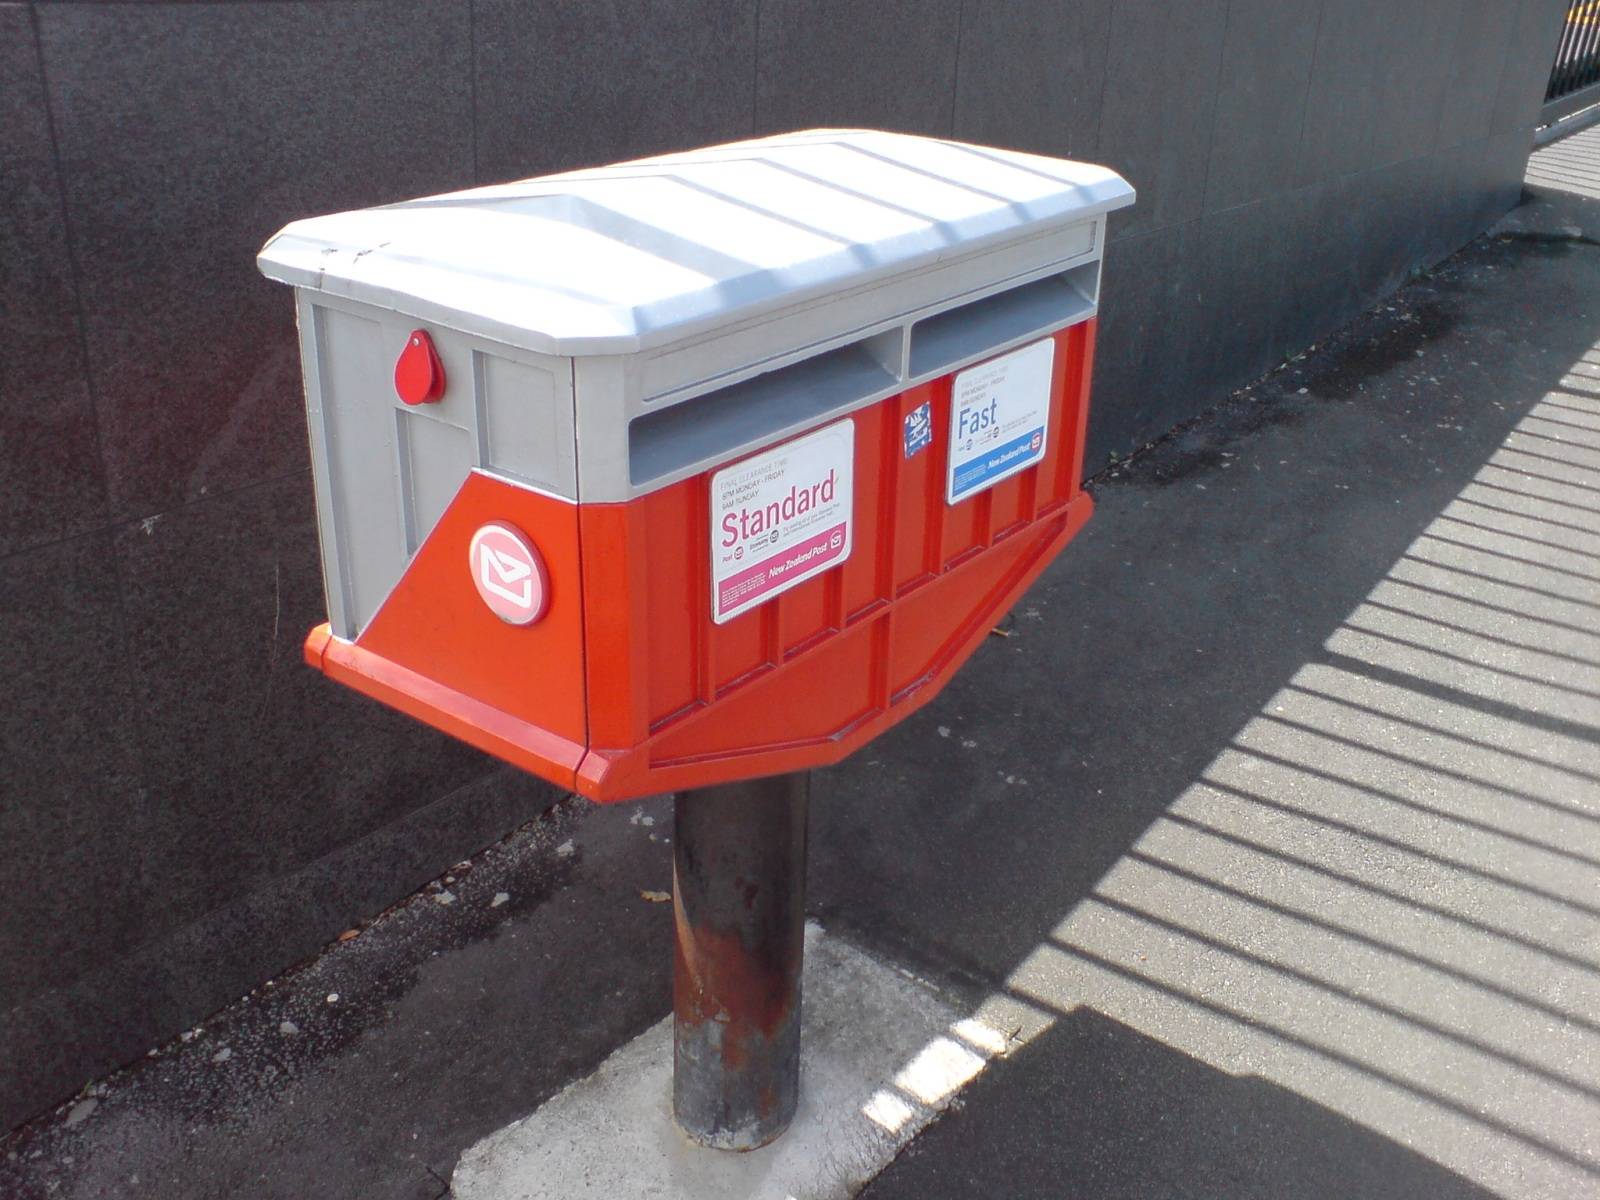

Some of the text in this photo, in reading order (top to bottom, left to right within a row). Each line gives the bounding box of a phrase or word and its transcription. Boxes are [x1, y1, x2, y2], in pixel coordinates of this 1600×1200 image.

[958, 397, 997, 440] Fast
[735, 479, 760, 493] MONDAY
[765, 469, 785, 483] FRIDAY
[721, 468, 835, 547] Standard
[768, 565, 785, 579] New
[785, 547, 813, 570] Zealand
[812, 542, 828, 557] Post
